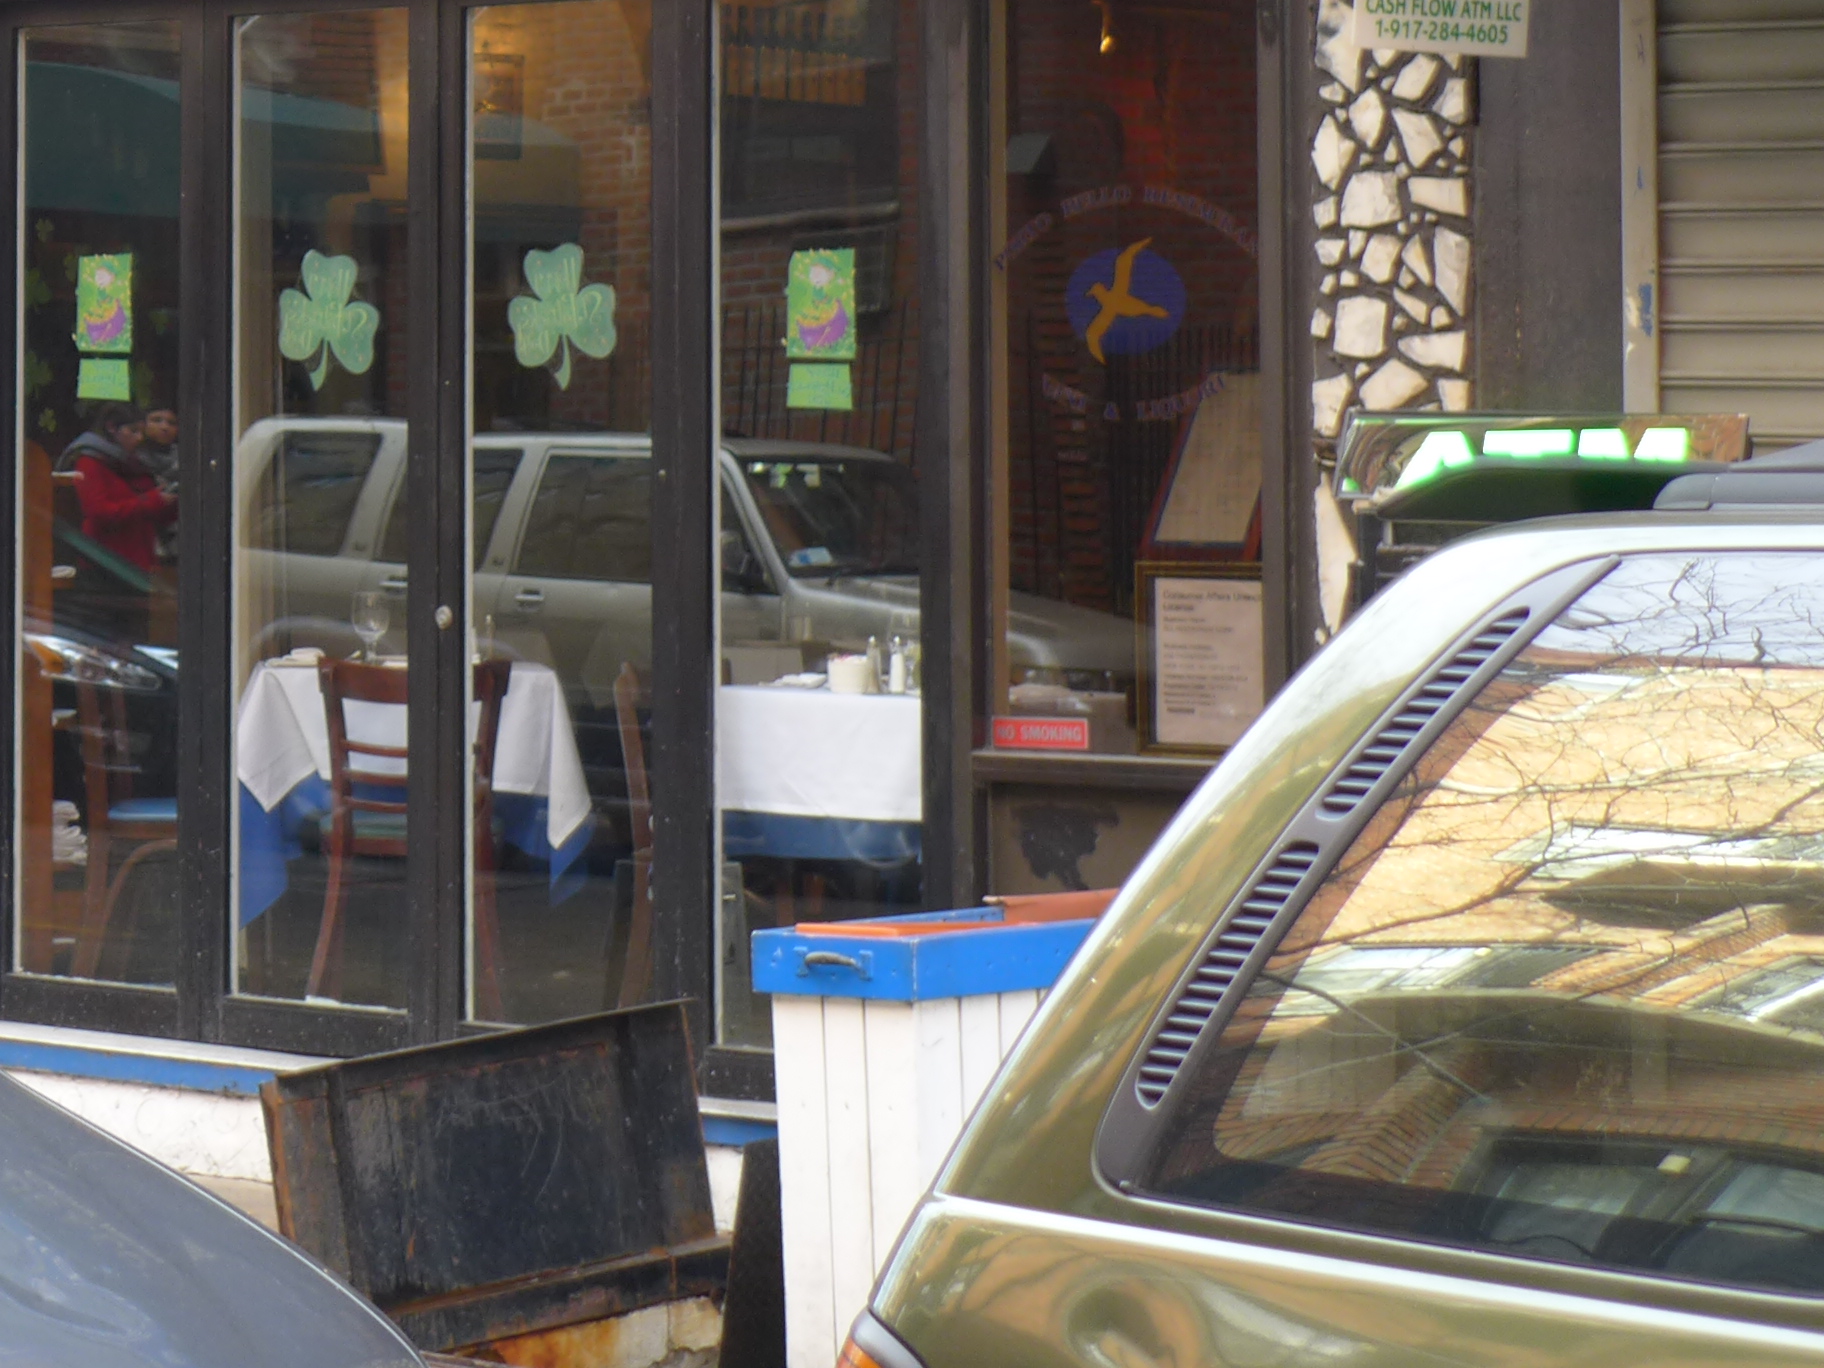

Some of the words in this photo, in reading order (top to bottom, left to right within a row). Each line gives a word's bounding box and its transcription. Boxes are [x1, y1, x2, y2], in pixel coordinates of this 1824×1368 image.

[1461, 0, 1492, 20] ATM
[1496, 1, 1522, 22] LLC
[1375, 18, 1508, 44] 1-917-284-4605
[998, 725, 1015, 740] NO
[1020, 725, 1082, 742] SMOKING
